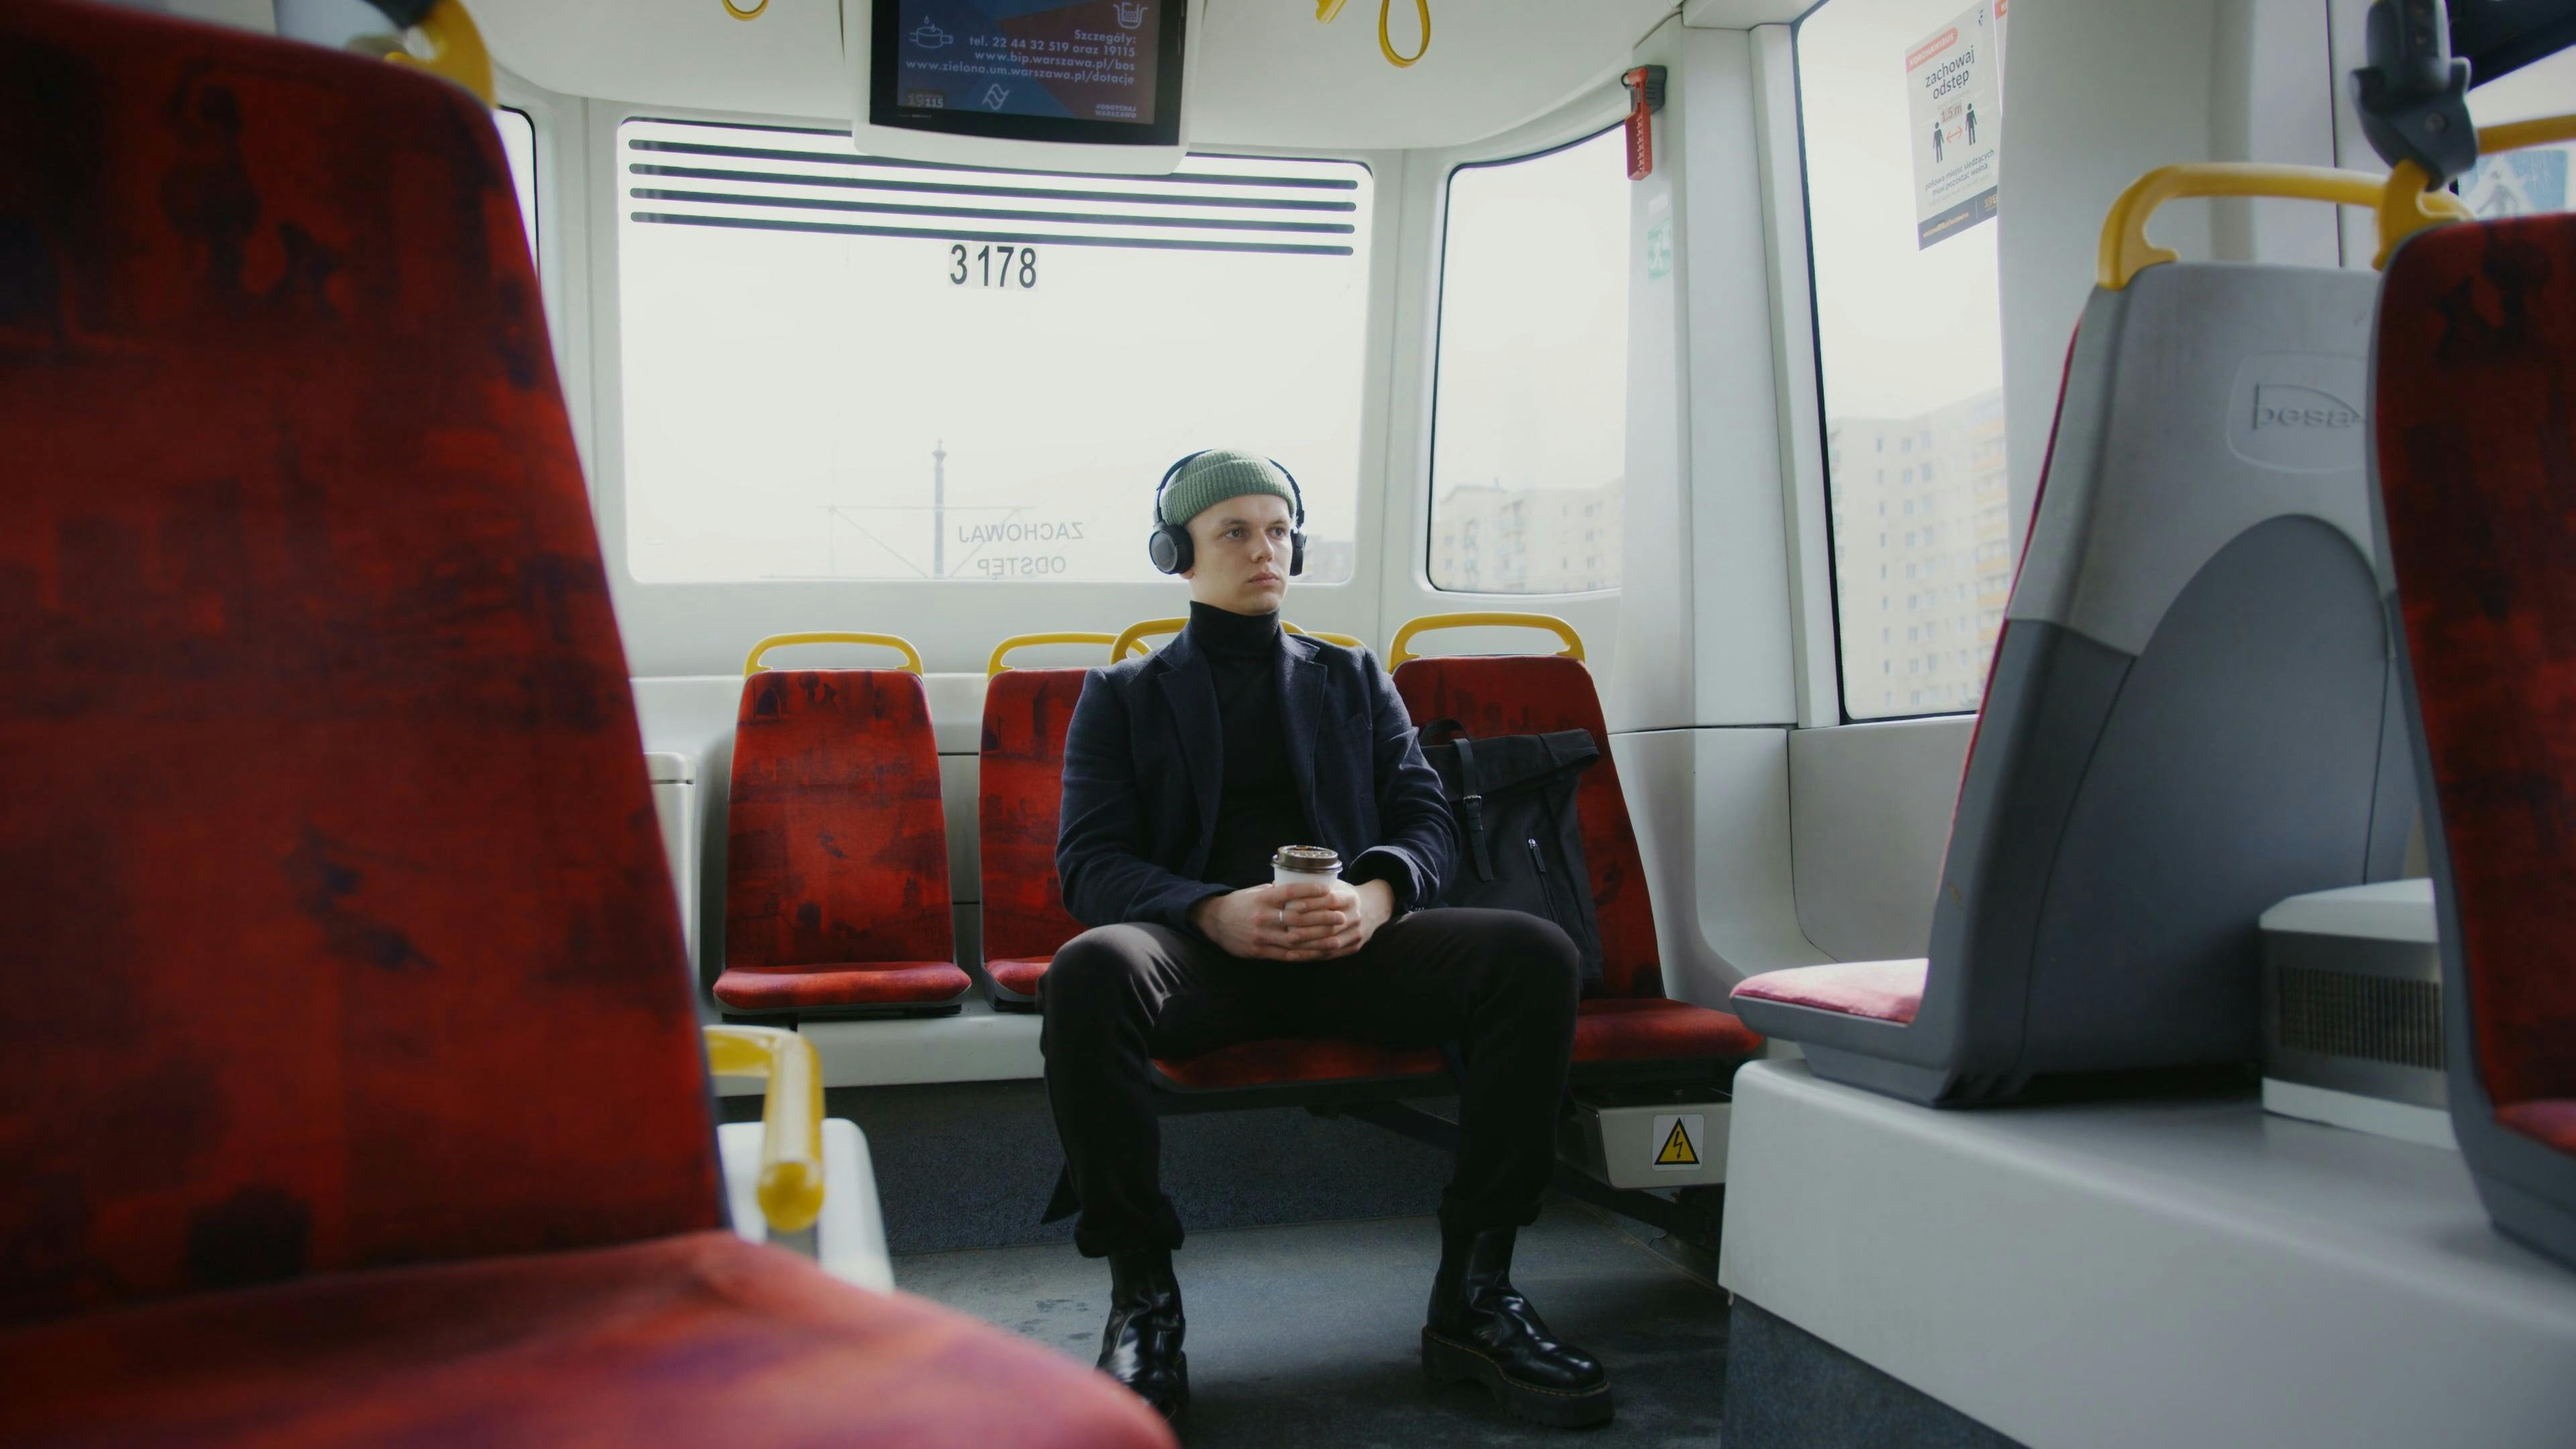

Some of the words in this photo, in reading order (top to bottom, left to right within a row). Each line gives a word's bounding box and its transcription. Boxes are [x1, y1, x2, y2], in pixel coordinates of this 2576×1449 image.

[969, 36, 987, 46] tel.
[992, 37, 1006, 48] 22
[1011, 38, 1026, 49] 44
[1030, 40, 1044, 50] 32
[1049, 42, 1069, 52] 519
[1073, 46, 1099, 54] oraz
[1104, 46, 1135, 57] 19115
[1075, 30, 1136, 46] Szczegóły:
[906, 60, 1134, 85] www.zielona.um.warszawa.pl/dotacje
[975, 52, 1135, 71] www.bip.warszawa.pl/bos
[1925, 45, 1974, 88] zachowaj
[1933, 70, 1969, 99] odstęp
[1955, 104, 1962, 115] m
[951, 244, 1036, 288] 3178
